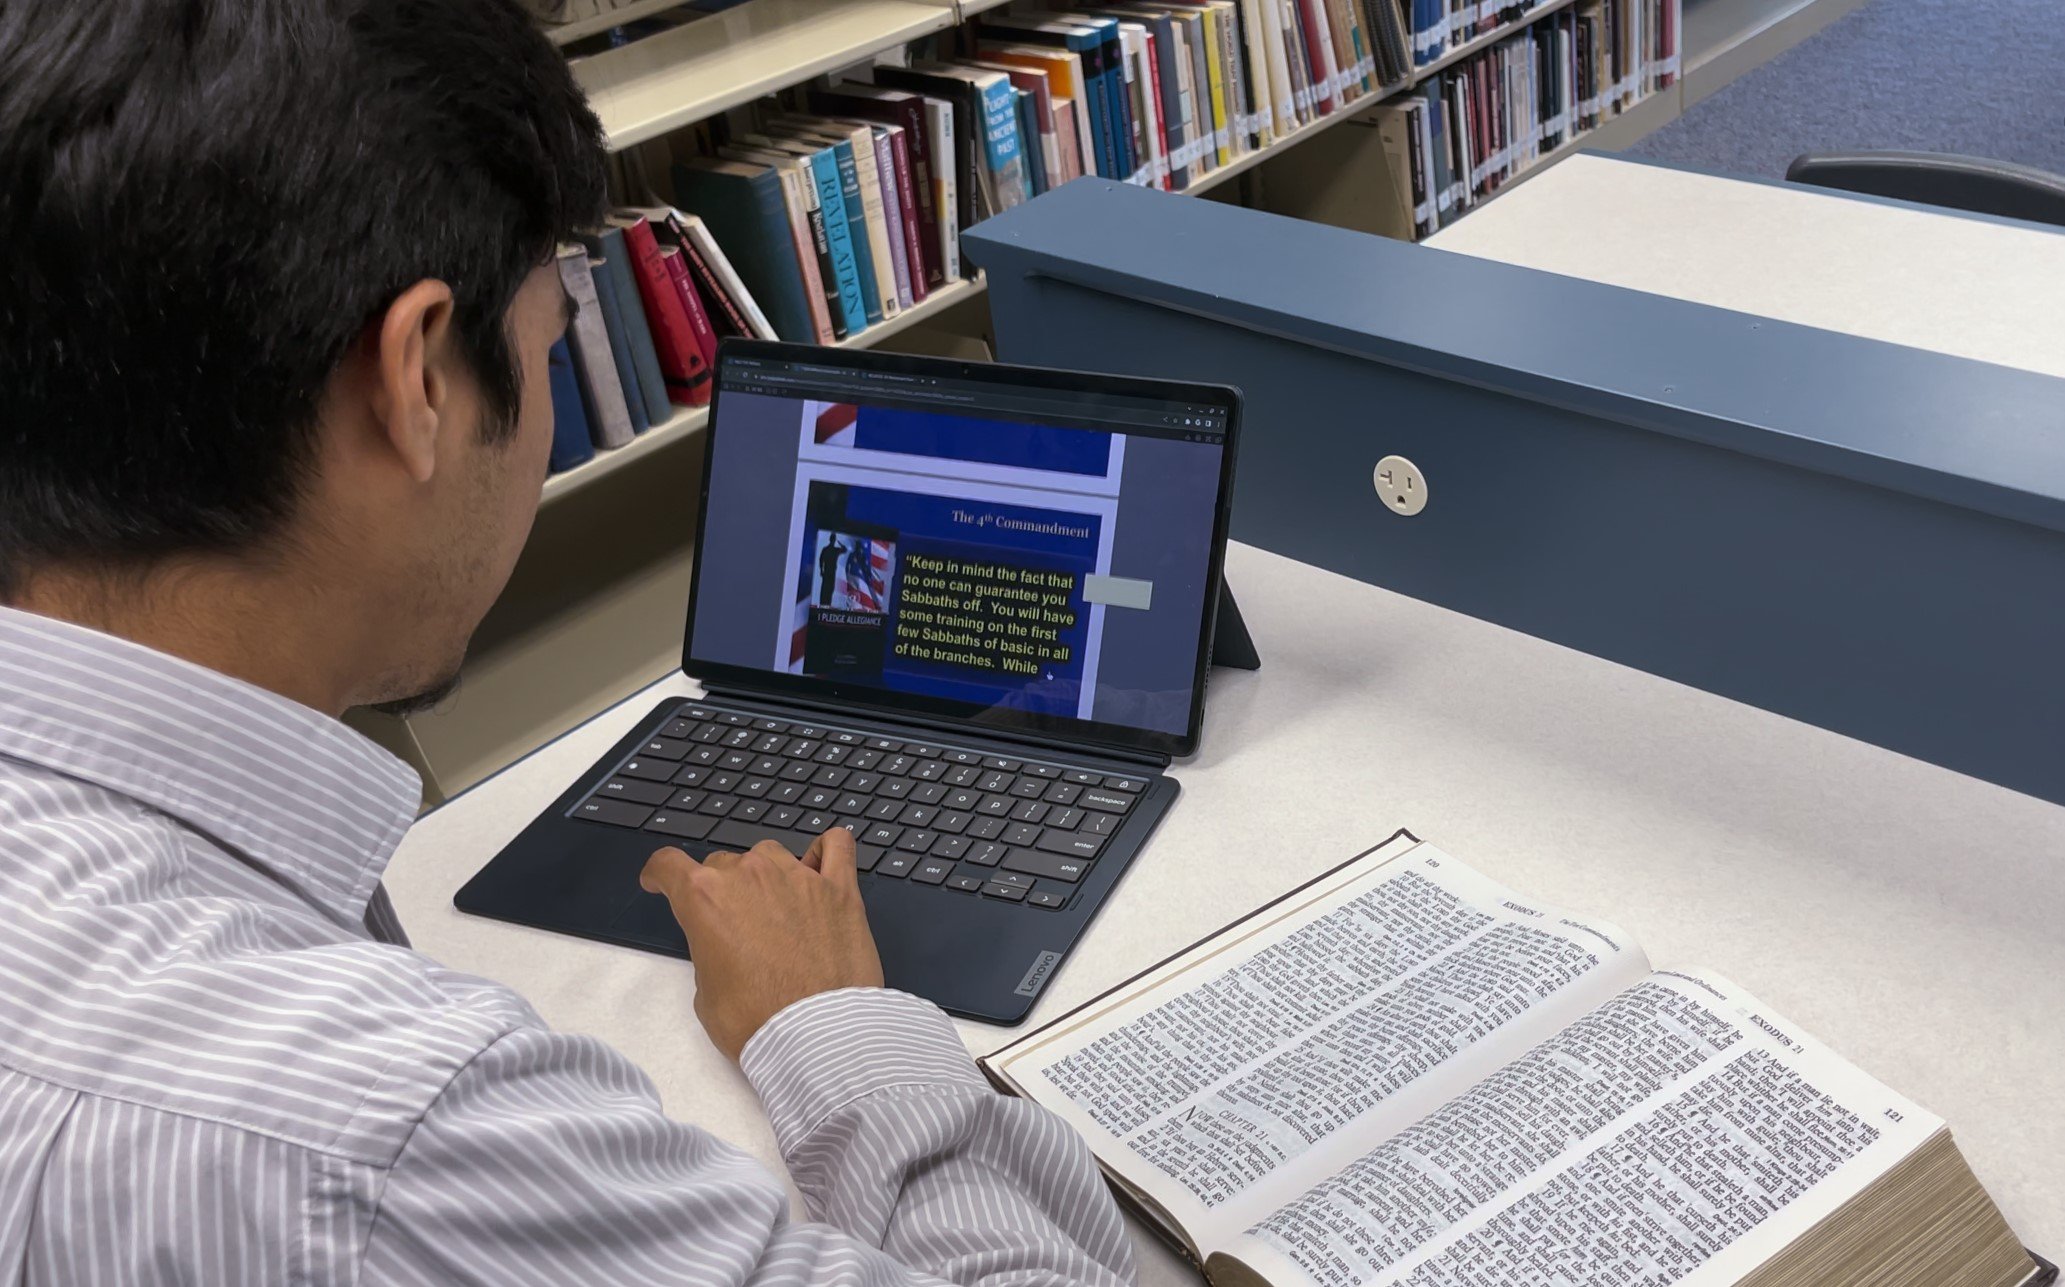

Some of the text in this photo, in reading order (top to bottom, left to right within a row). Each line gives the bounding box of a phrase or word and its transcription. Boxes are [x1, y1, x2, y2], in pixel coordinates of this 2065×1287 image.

[821, 177, 859, 314] REVELATION
[952, 510, 1089, 539] The 4th Commandment
[903, 574, 1066, 606] no one can guarantee you
[947, 560, 958, 574] in
[962, 563, 993, 578] mind
[997, 568, 1016, 581] the
[1021, 571, 1044, 584] fact
[1048, 574, 1073, 589] that
[822, 613, 845, 623] PLEDGE
[847, 616, 881, 625] ALLEGIANCE
[902, 590, 1074, 625] Sabbaths off. You will have
[899, 609, 1057, 641] some training on the first
[897, 624, 1069, 660] few Sabbaths of basic in all
[895, 643, 1038, 674] of the branches. While
[1088, 794, 1126, 806] backspace
[1074, 841, 1094, 849] enter
[1061, 864, 1078, 872] shift
[1425, 858, 1439, 868] 120
[1503, 900, 1537, 917] EXODUS
[1021, 955, 1054, 992] Lenovo
[1659, 1004, 1729, 1050] then his wife shall
[1749, 1014, 1805, 1054] EXODUS 21
[1723, 1061, 1747, 1081] place
[1746, 1077, 1778, 1103] whither
[1787, 1110, 1813, 1127] shall
[1806, 1123, 1826, 1139] flee.
[1733, 1055, 1758, 1076] hand;
[1757, 1074, 1778, 1091] then
[1786, 1095, 1805, 1110] will
[1798, 1108, 1837, 1133] appoint
[1835, 1131, 1855, 1146] thee
[1741, 1050, 1874, 1145] but God deliver him into his
[1766, 1058, 1789, 1073] And
[1799, 1082, 1822, 1098] man
[1819, 1094, 1833, 1105] lie
[1831, 1103, 1850, 1116] not
[1859, 1121, 1880, 1139] wait,
[1219, 1110, 1268, 1141] CHAPTER 21
[1730, 1078, 1749, 1093] But
[1762, 1103, 1782, 1120] man
[1781, 1118, 1805, 1137] come
[1801, 1135, 1844, 1164] presump-
[1883, 1107, 1904, 1124] 121
[1204, 1151, 1244, 1188] Hebrew serv-
[1236, 1140, 1276, 1170] judgments
[1244, 1154, 1266, 1176] before
